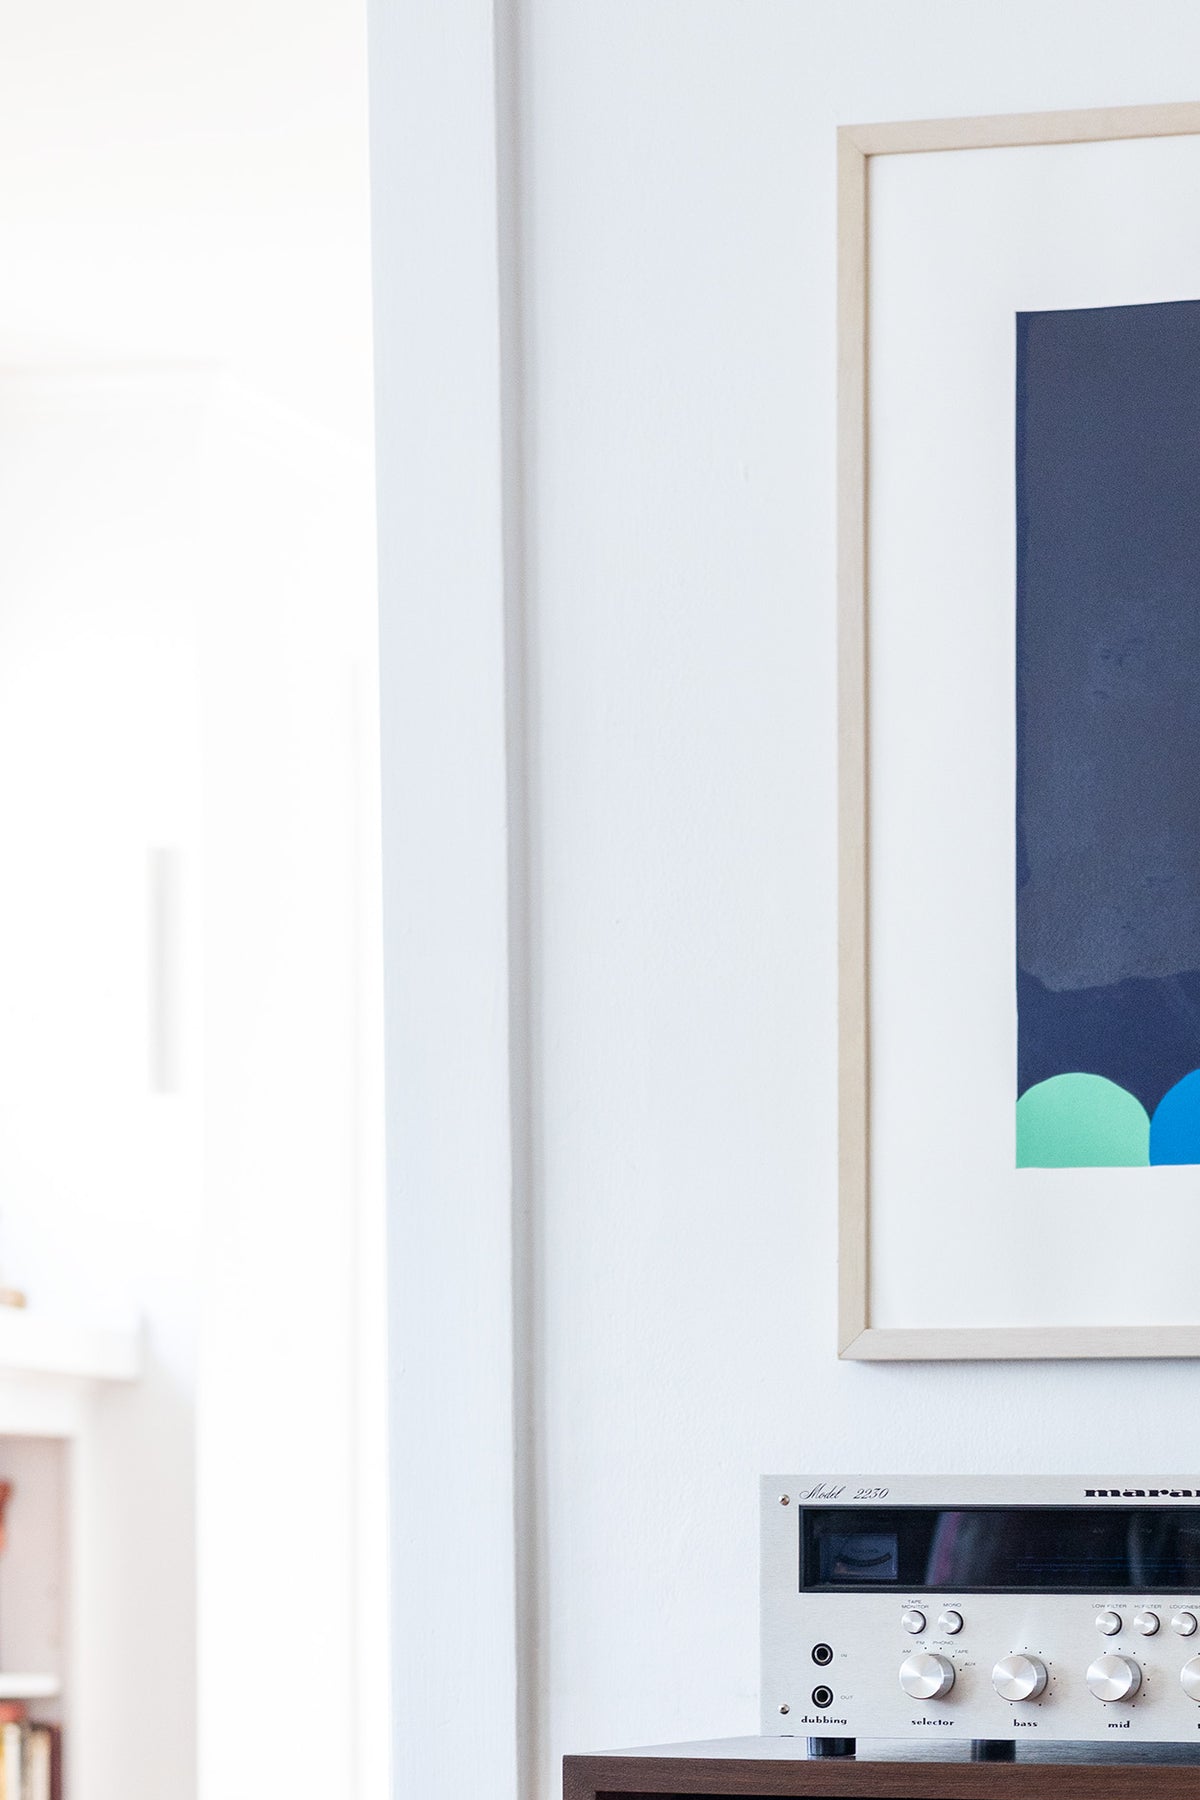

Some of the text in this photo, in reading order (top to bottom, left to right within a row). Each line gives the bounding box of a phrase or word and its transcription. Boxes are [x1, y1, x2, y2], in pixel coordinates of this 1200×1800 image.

[799, 1483, 890, 1500] Model 2230
[800, 1716, 848, 1725] dubbing
[911, 1718, 955, 1726] selector
[1013, 1719, 1038, 1727] bass
[1108, 1720, 1130, 1728] mid
